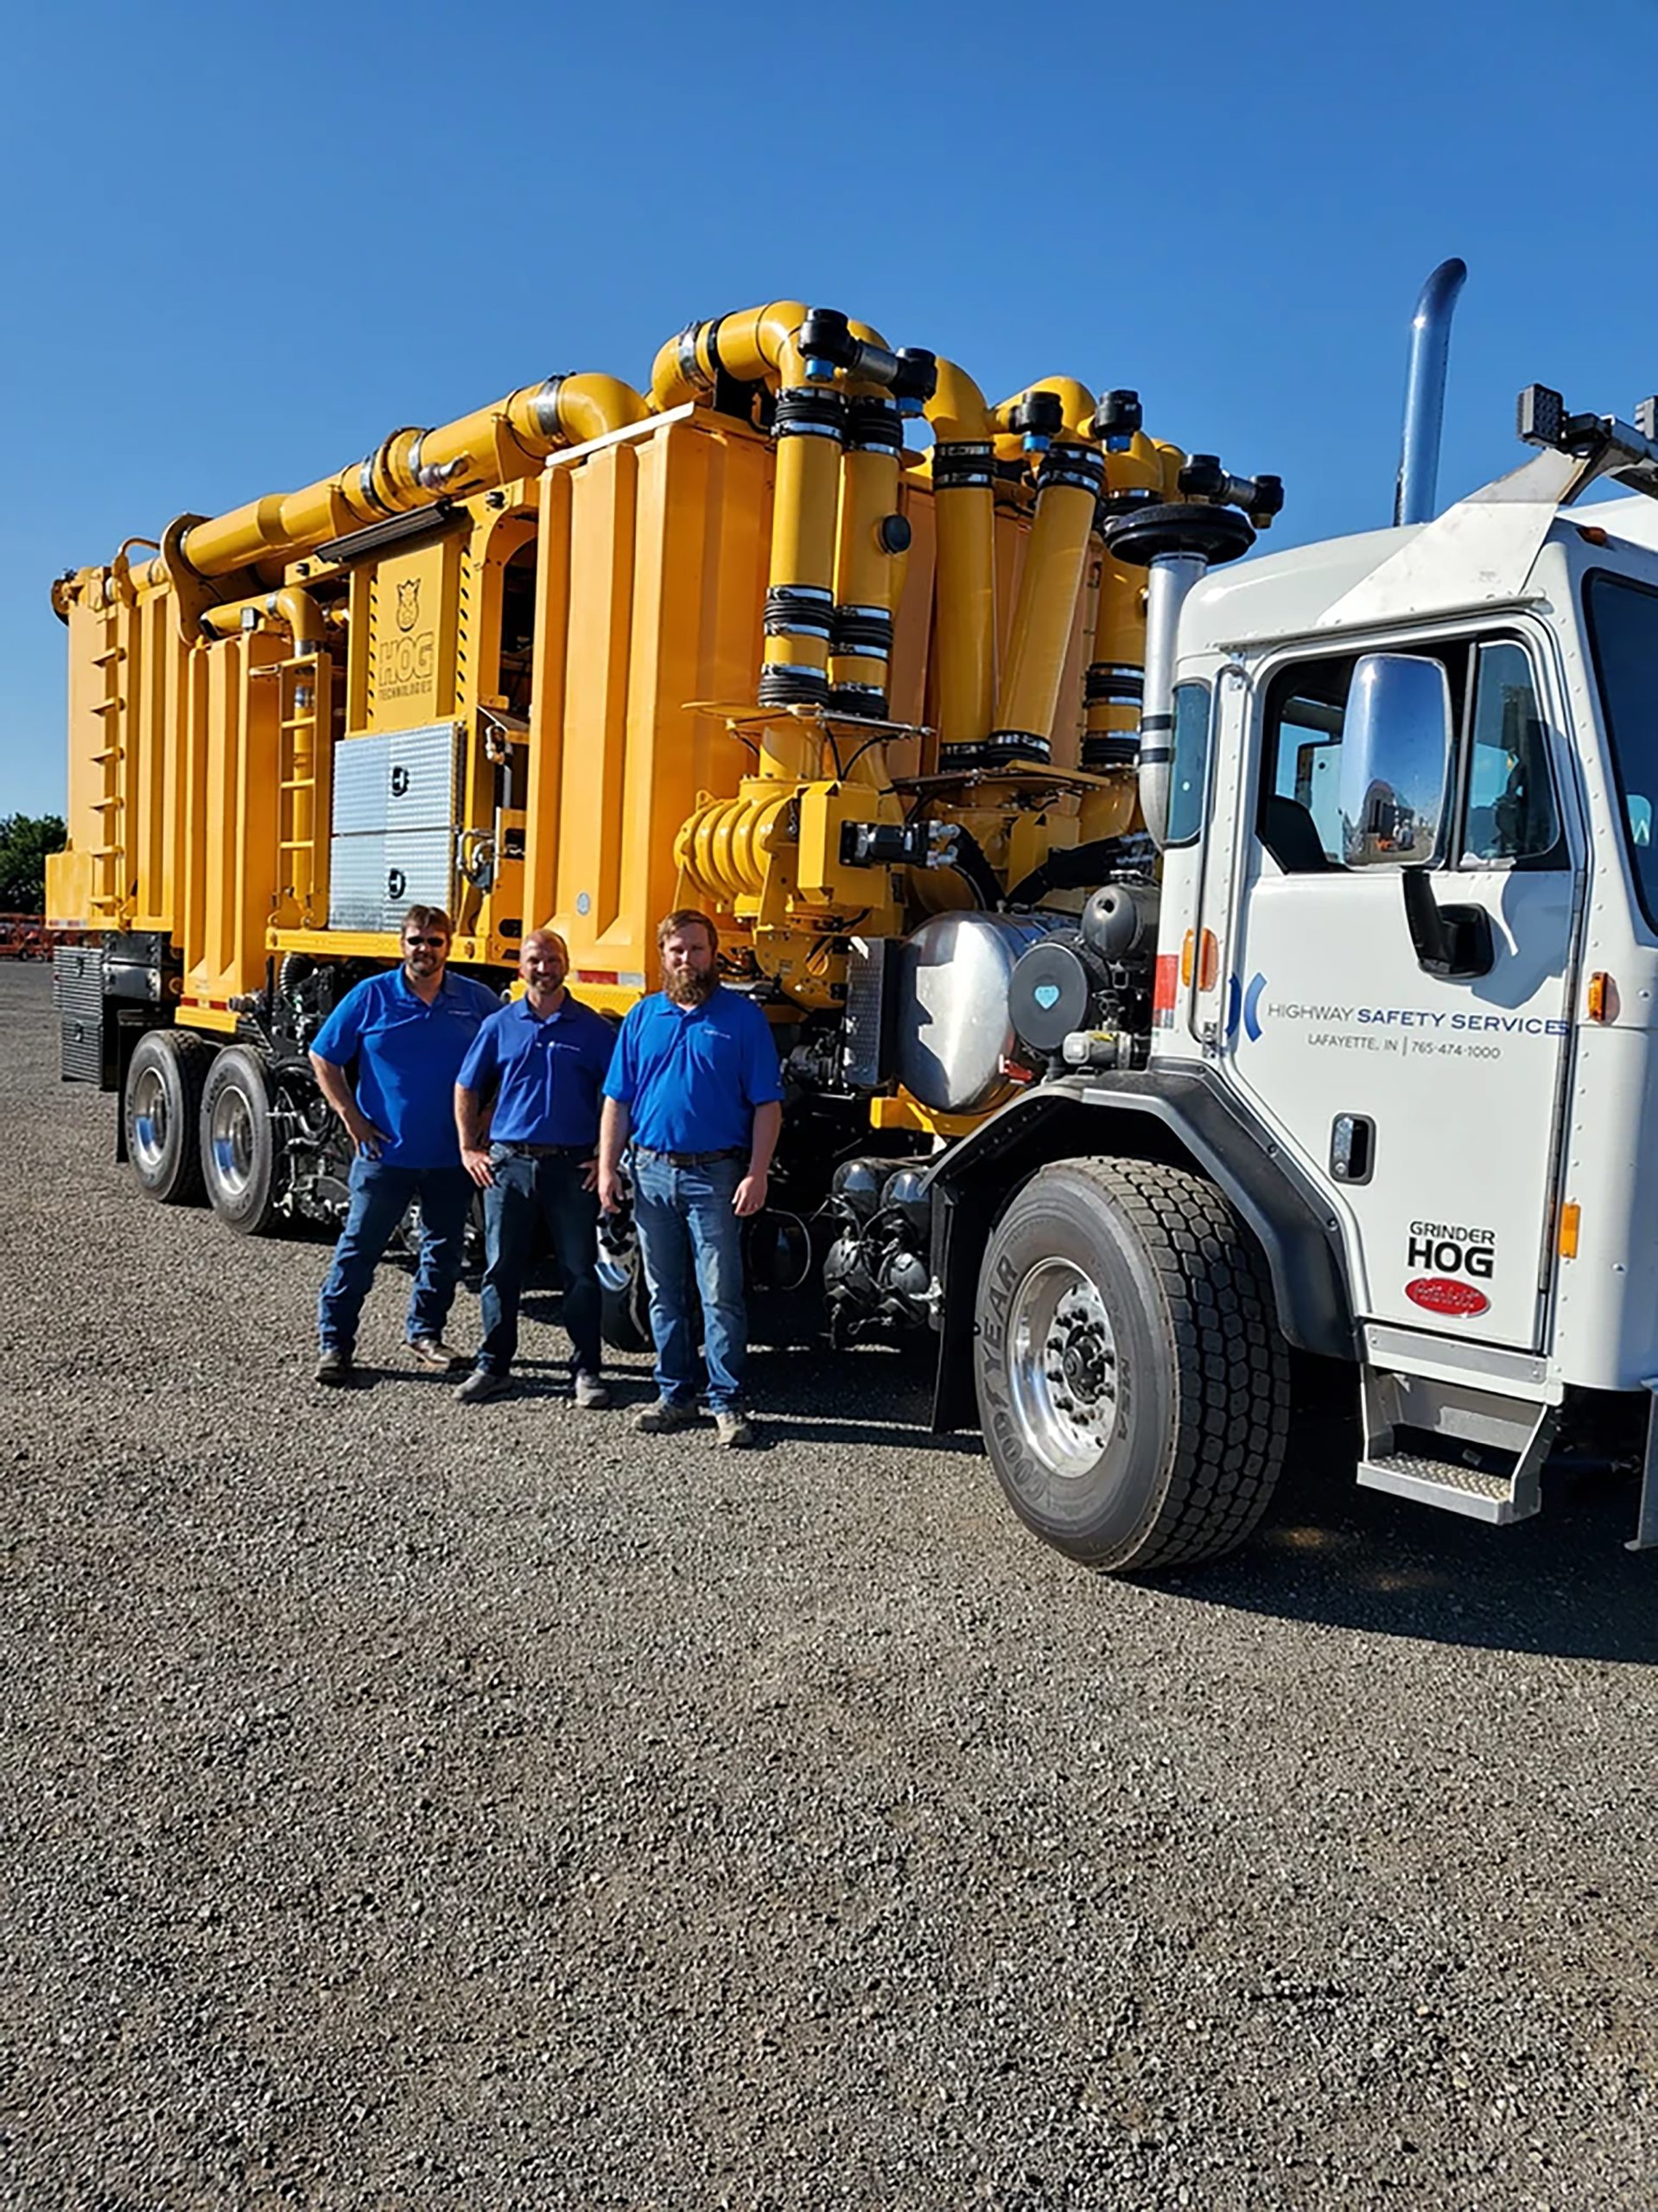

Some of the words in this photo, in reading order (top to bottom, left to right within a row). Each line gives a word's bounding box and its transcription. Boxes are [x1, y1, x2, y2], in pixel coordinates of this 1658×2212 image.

[378, 630, 434, 688] HOG
[378, 679, 433, 702] TECHNOLOGIES
[1267, 1003, 1354, 1021] HIGHWAY
[1357, 1008, 1445, 1027] SAFETY
[1451, 1014, 1570, 1036] SERVICES
[1308, 1033, 1380, 1051] LAFAYETTE,
[1384, 1039, 1398, 1052] IN
[1409, 1221, 1496, 1246] GRINDER
[1407, 1236, 1494, 1279] HOG
